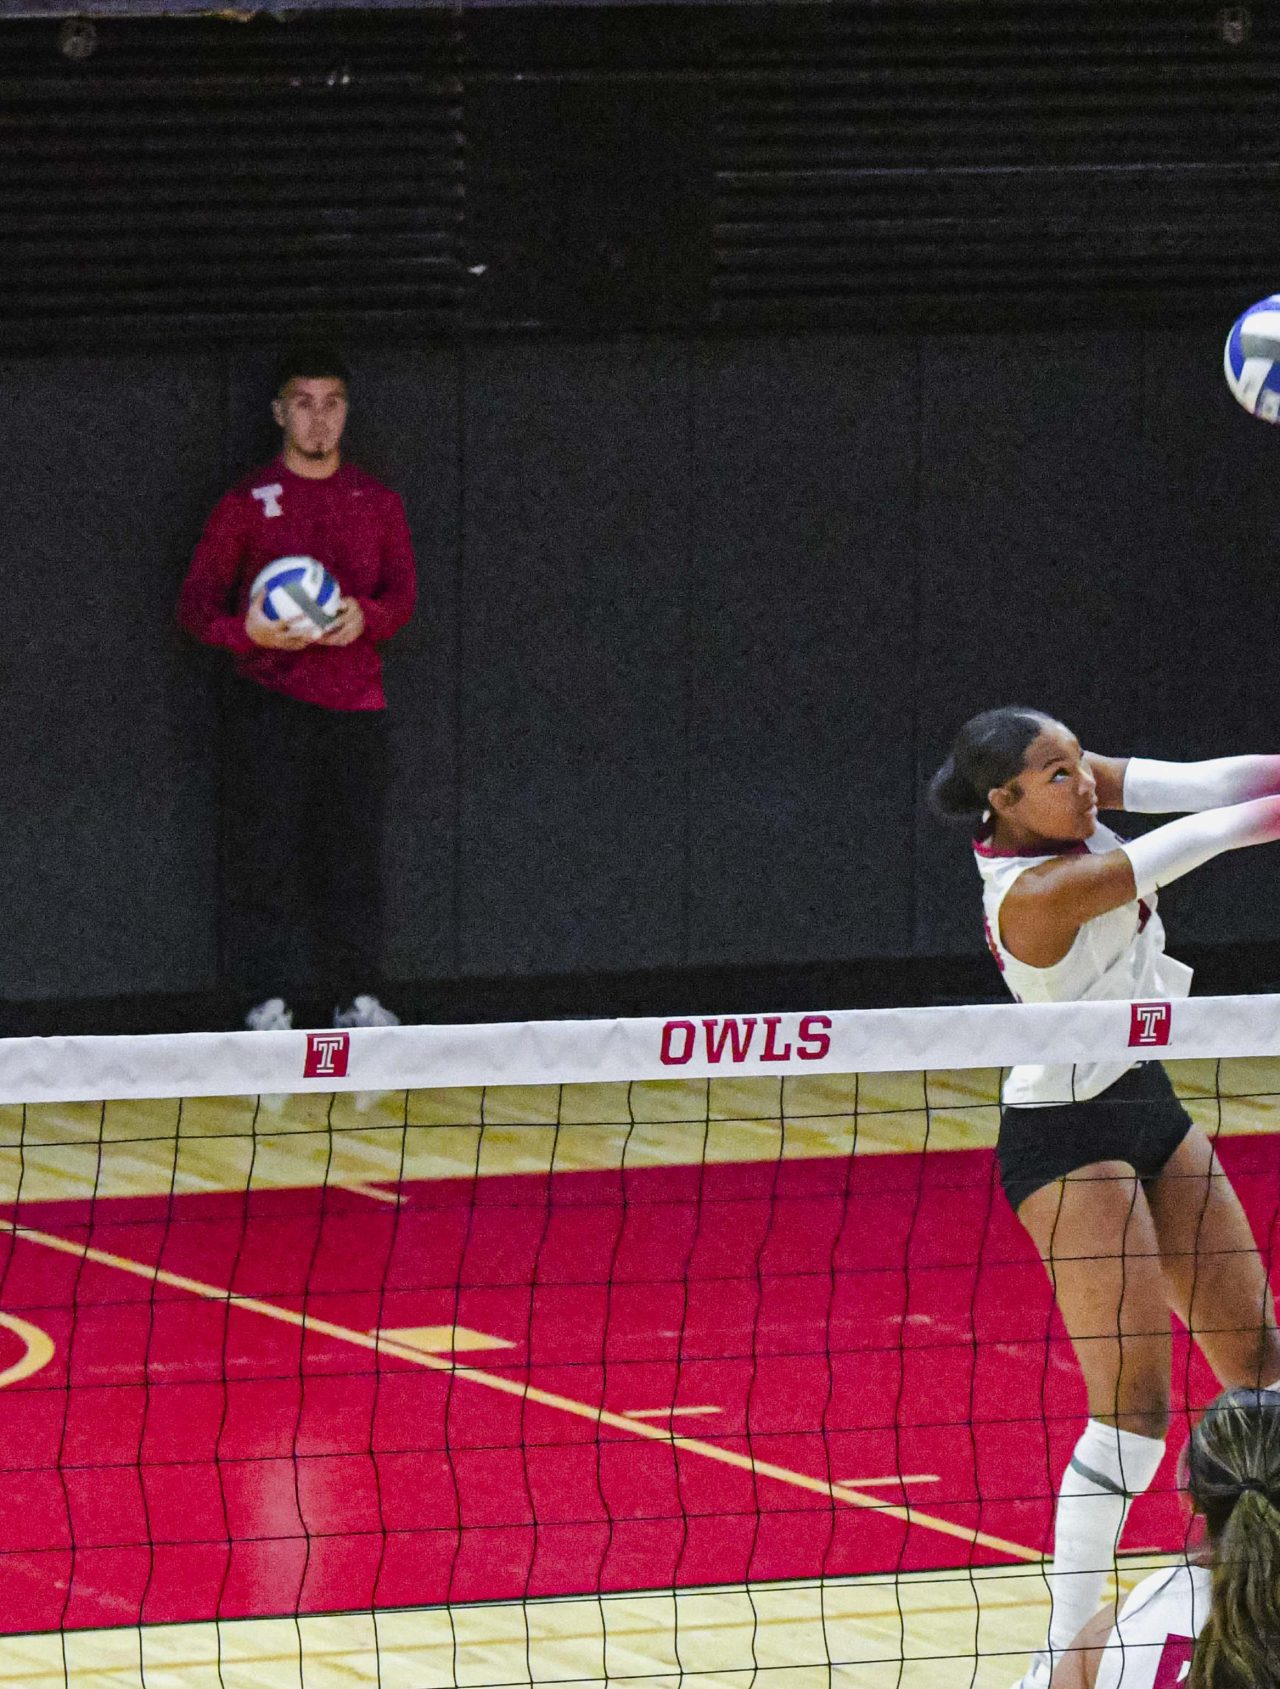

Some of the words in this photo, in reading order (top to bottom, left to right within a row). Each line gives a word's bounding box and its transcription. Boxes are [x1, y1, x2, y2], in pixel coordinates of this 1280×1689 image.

[252, 483, 284, 518] T
[660, 1015, 833, 1066] OWLS
[1137, 1006, 1166, 1042] T
[313, 1036, 344, 1073] T
